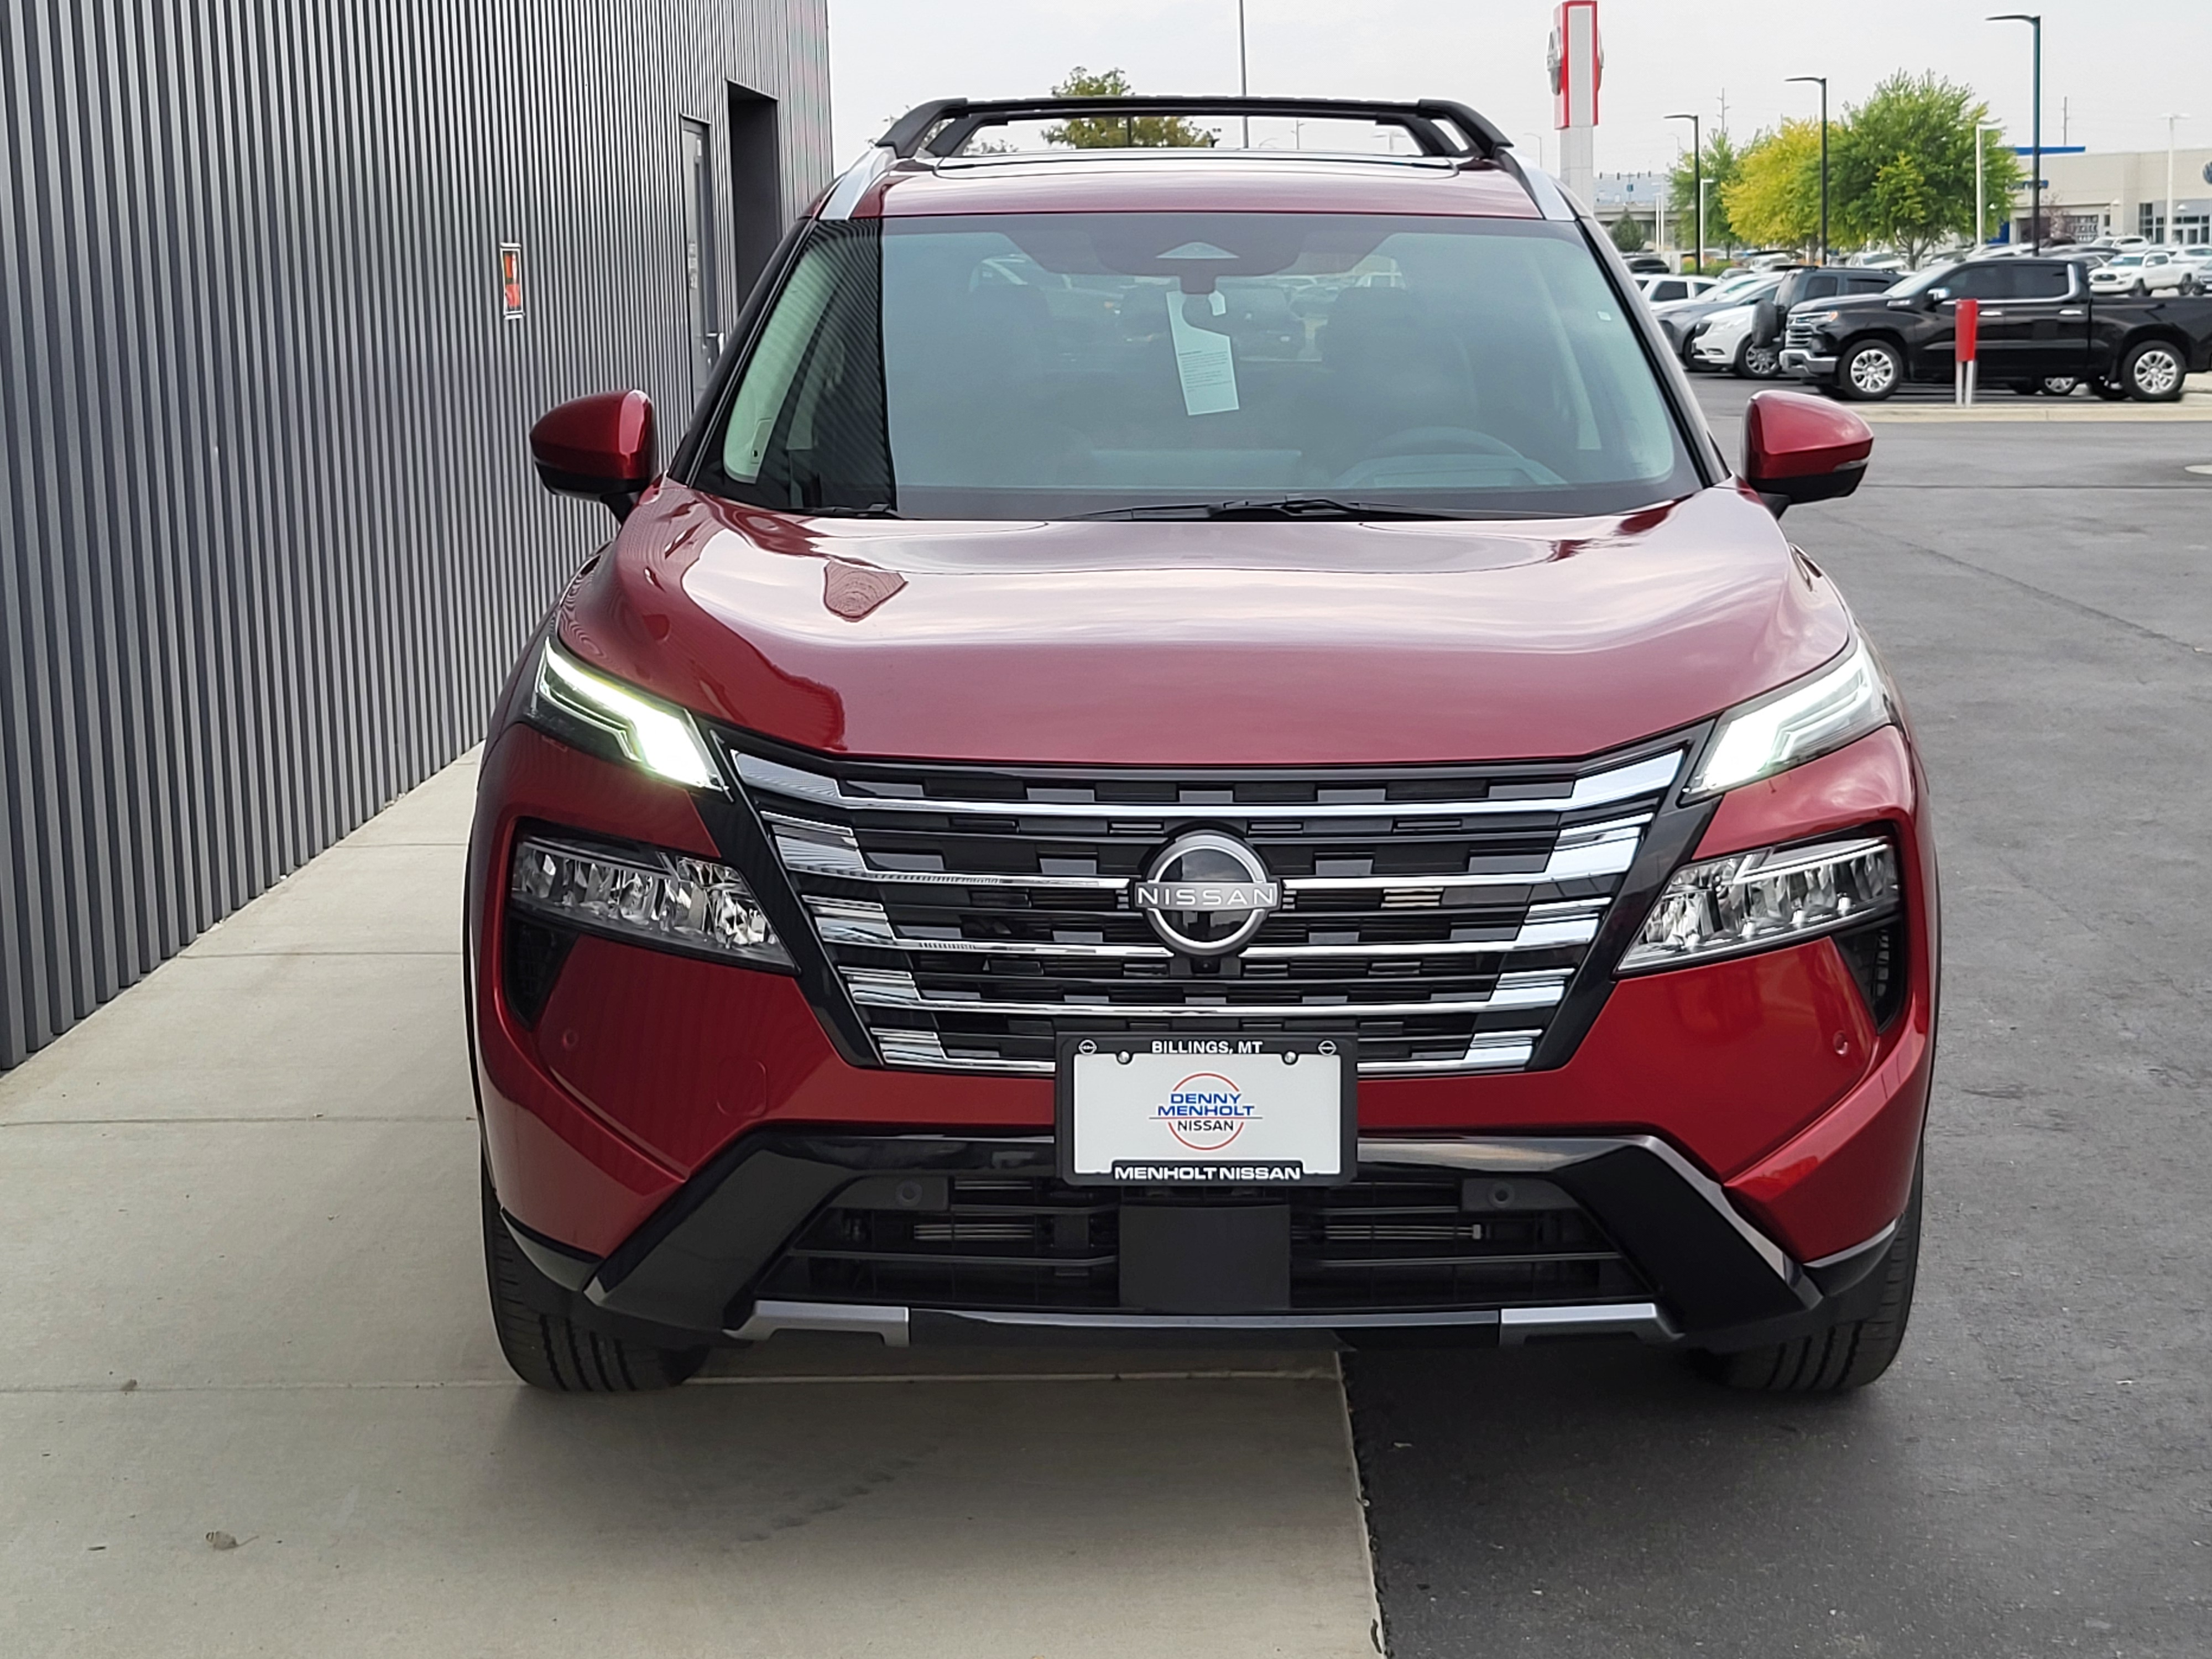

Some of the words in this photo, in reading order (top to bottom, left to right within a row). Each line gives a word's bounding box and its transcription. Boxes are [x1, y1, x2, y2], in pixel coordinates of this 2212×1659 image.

[1138, 887, 1272, 905] NISSAN
[1152, 1041, 1233, 1055] BILLINGS,
[1238, 1041, 1263, 1053] MT
[1171, 1093, 1241, 1104] DENNY
[1158, 1105, 1255, 1116] MENHOLT
[1177, 1120, 1234, 1131] NISSAN
[1115, 1167, 1217, 1180] MENHOLT
[1219, 1167, 1300, 1180] NISSAN
